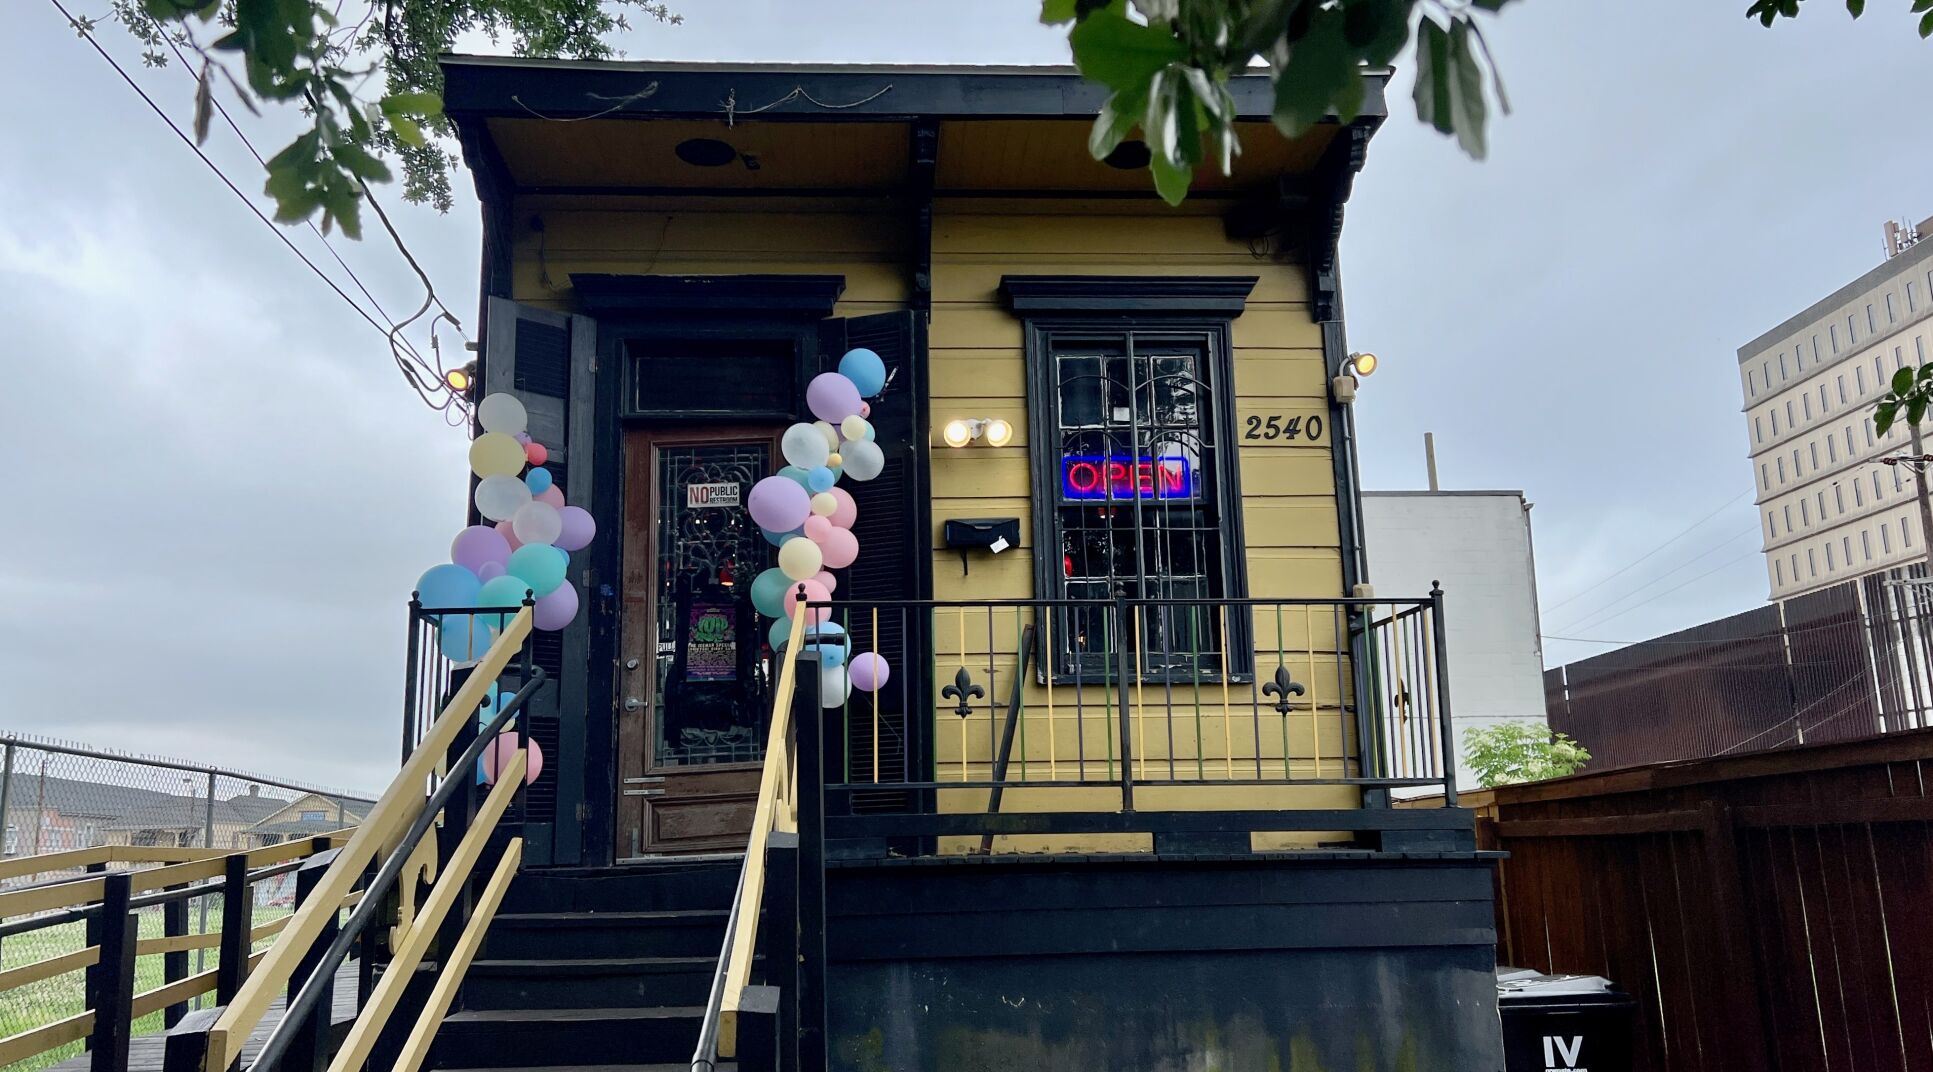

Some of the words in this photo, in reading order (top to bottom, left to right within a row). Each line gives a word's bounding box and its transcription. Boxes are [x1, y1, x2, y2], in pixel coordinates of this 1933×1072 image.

[1245, 415, 1323, 441] 2540
[1069, 462, 1182, 491] OPEN
[689, 486, 709, 504] NO
[709, 485, 738, 496] PUBLIC
[1543, 1035, 1583, 1067] IV
